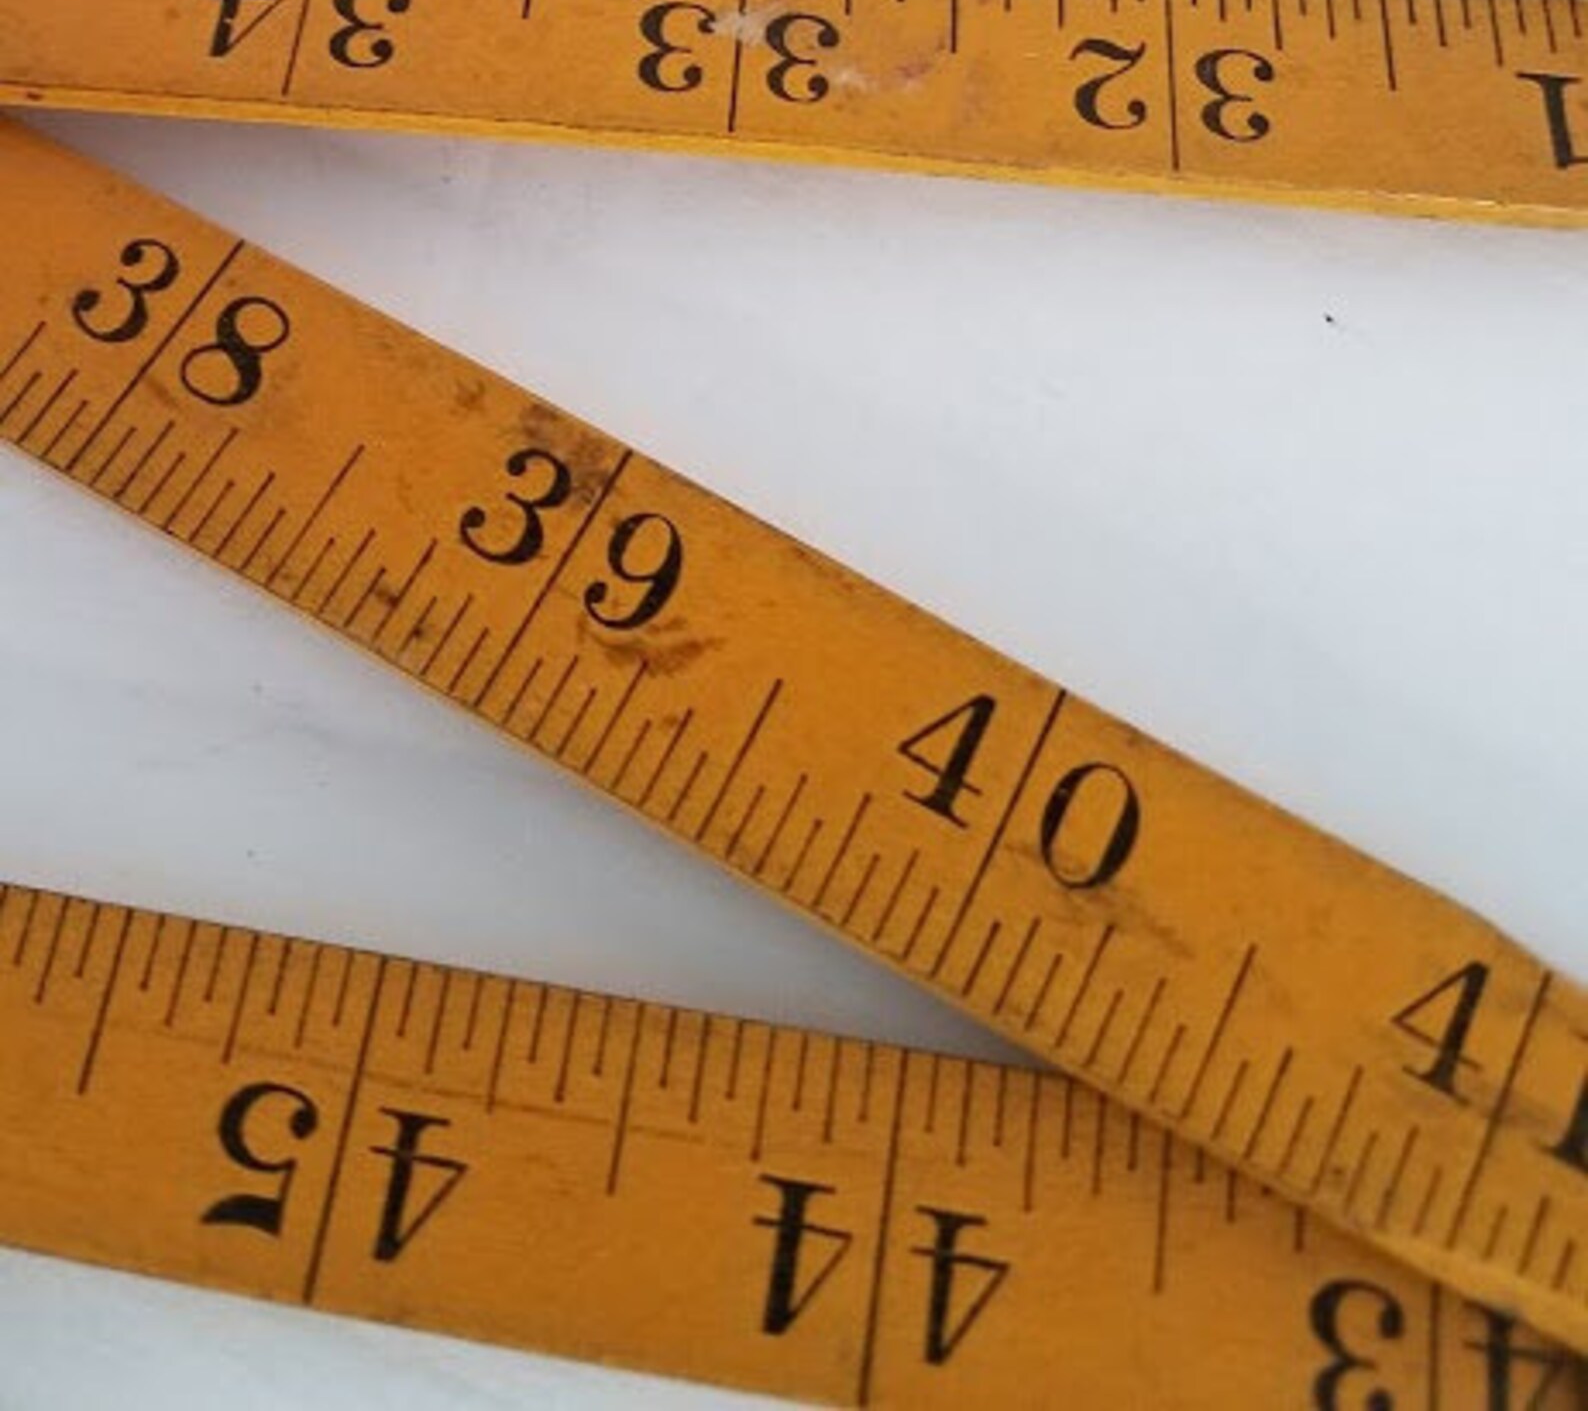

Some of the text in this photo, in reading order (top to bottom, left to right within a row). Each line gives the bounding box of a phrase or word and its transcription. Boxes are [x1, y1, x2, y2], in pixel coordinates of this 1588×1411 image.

[637, 0, 841, 104] 33
[1068, 38, 1275, 143] 32
[1514, 70, 1588, 171] 1
[70, 237, 291, 407] 38
[459, 446, 684, 631] 39
[896, 693, 1141, 891] 40
[198, 1081, 469, 1264] 45
[751, 1172, 1011, 1367] 44
